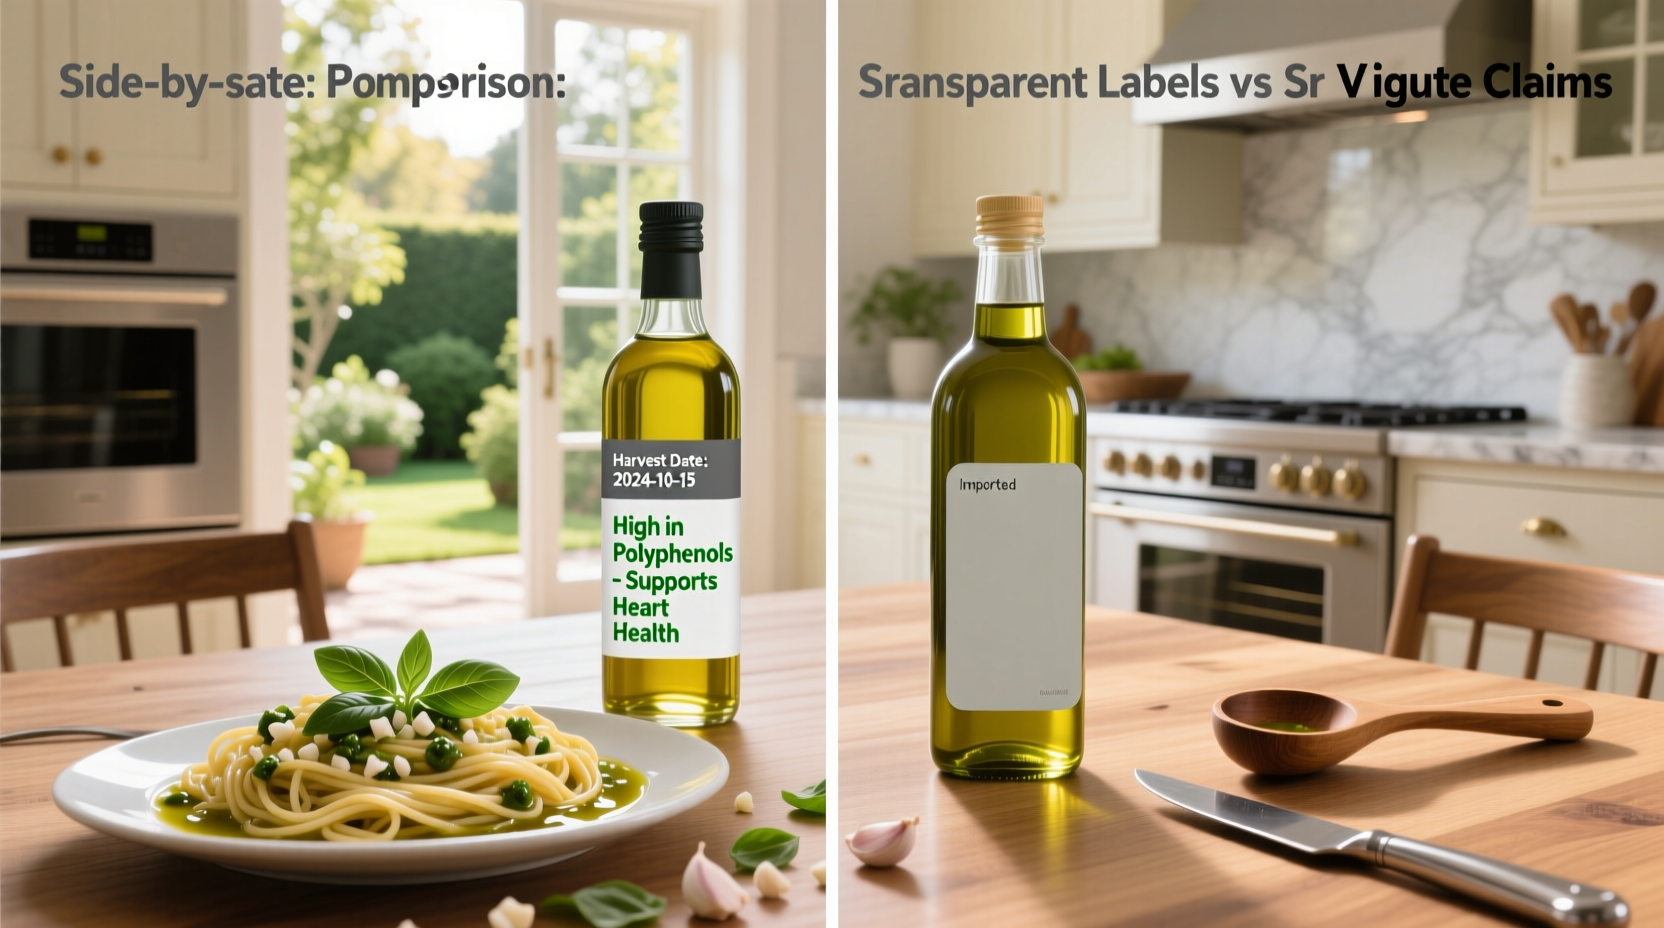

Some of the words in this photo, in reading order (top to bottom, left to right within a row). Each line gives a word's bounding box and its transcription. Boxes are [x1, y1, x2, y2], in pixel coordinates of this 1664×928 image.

[613, 453, 666, 467] Harvest
[670, 453, 708, 468] Date:
[613, 471, 696, 488] 2024-10-15
[960, 478, 1016, 494] Imported
[613, 515, 660, 541] High
[665, 515, 684, 536] in
[613, 542, 734, 568] Polyphenols
[626, 570, 718, 595] Supports
[613, 596, 669, 617] Heart
[613, 621, 680, 643] Health
